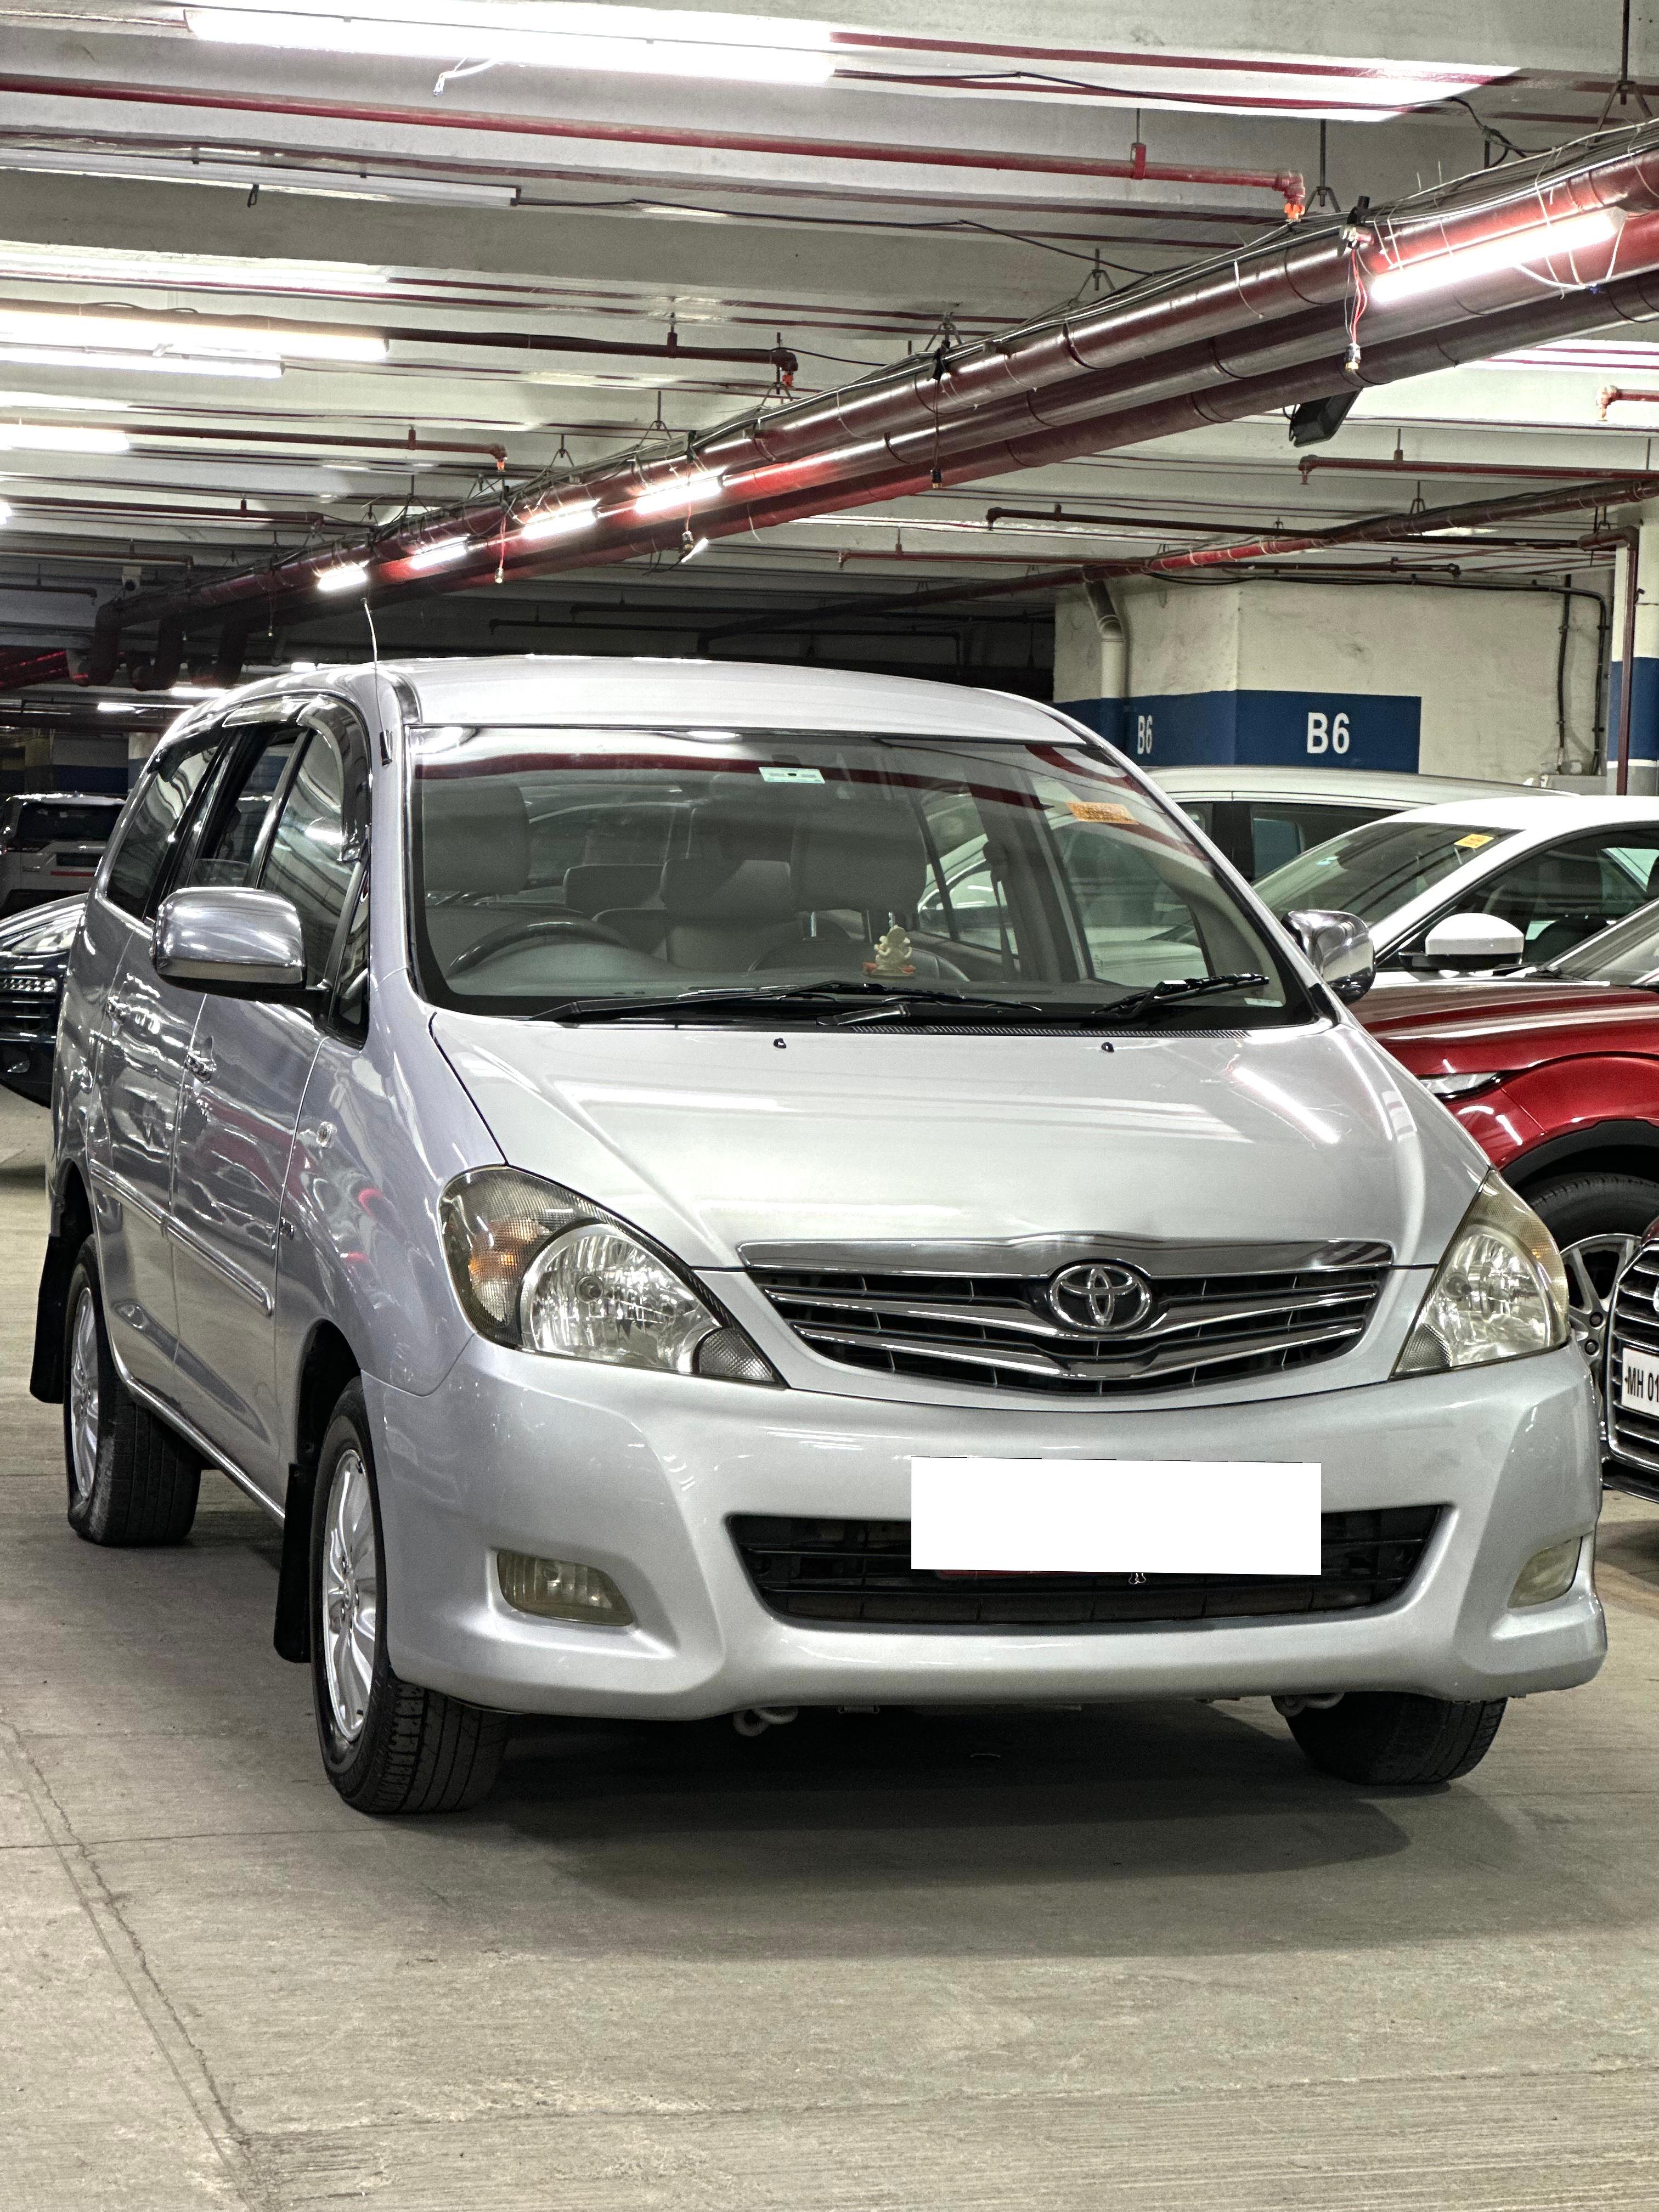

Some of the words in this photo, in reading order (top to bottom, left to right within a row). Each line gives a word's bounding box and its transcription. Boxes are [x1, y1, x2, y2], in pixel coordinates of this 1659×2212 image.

[1137, 715, 1153, 754] B6
[1307, 712, 1350, 754] B6
[1627, 1366, 1644, 1398] MH
